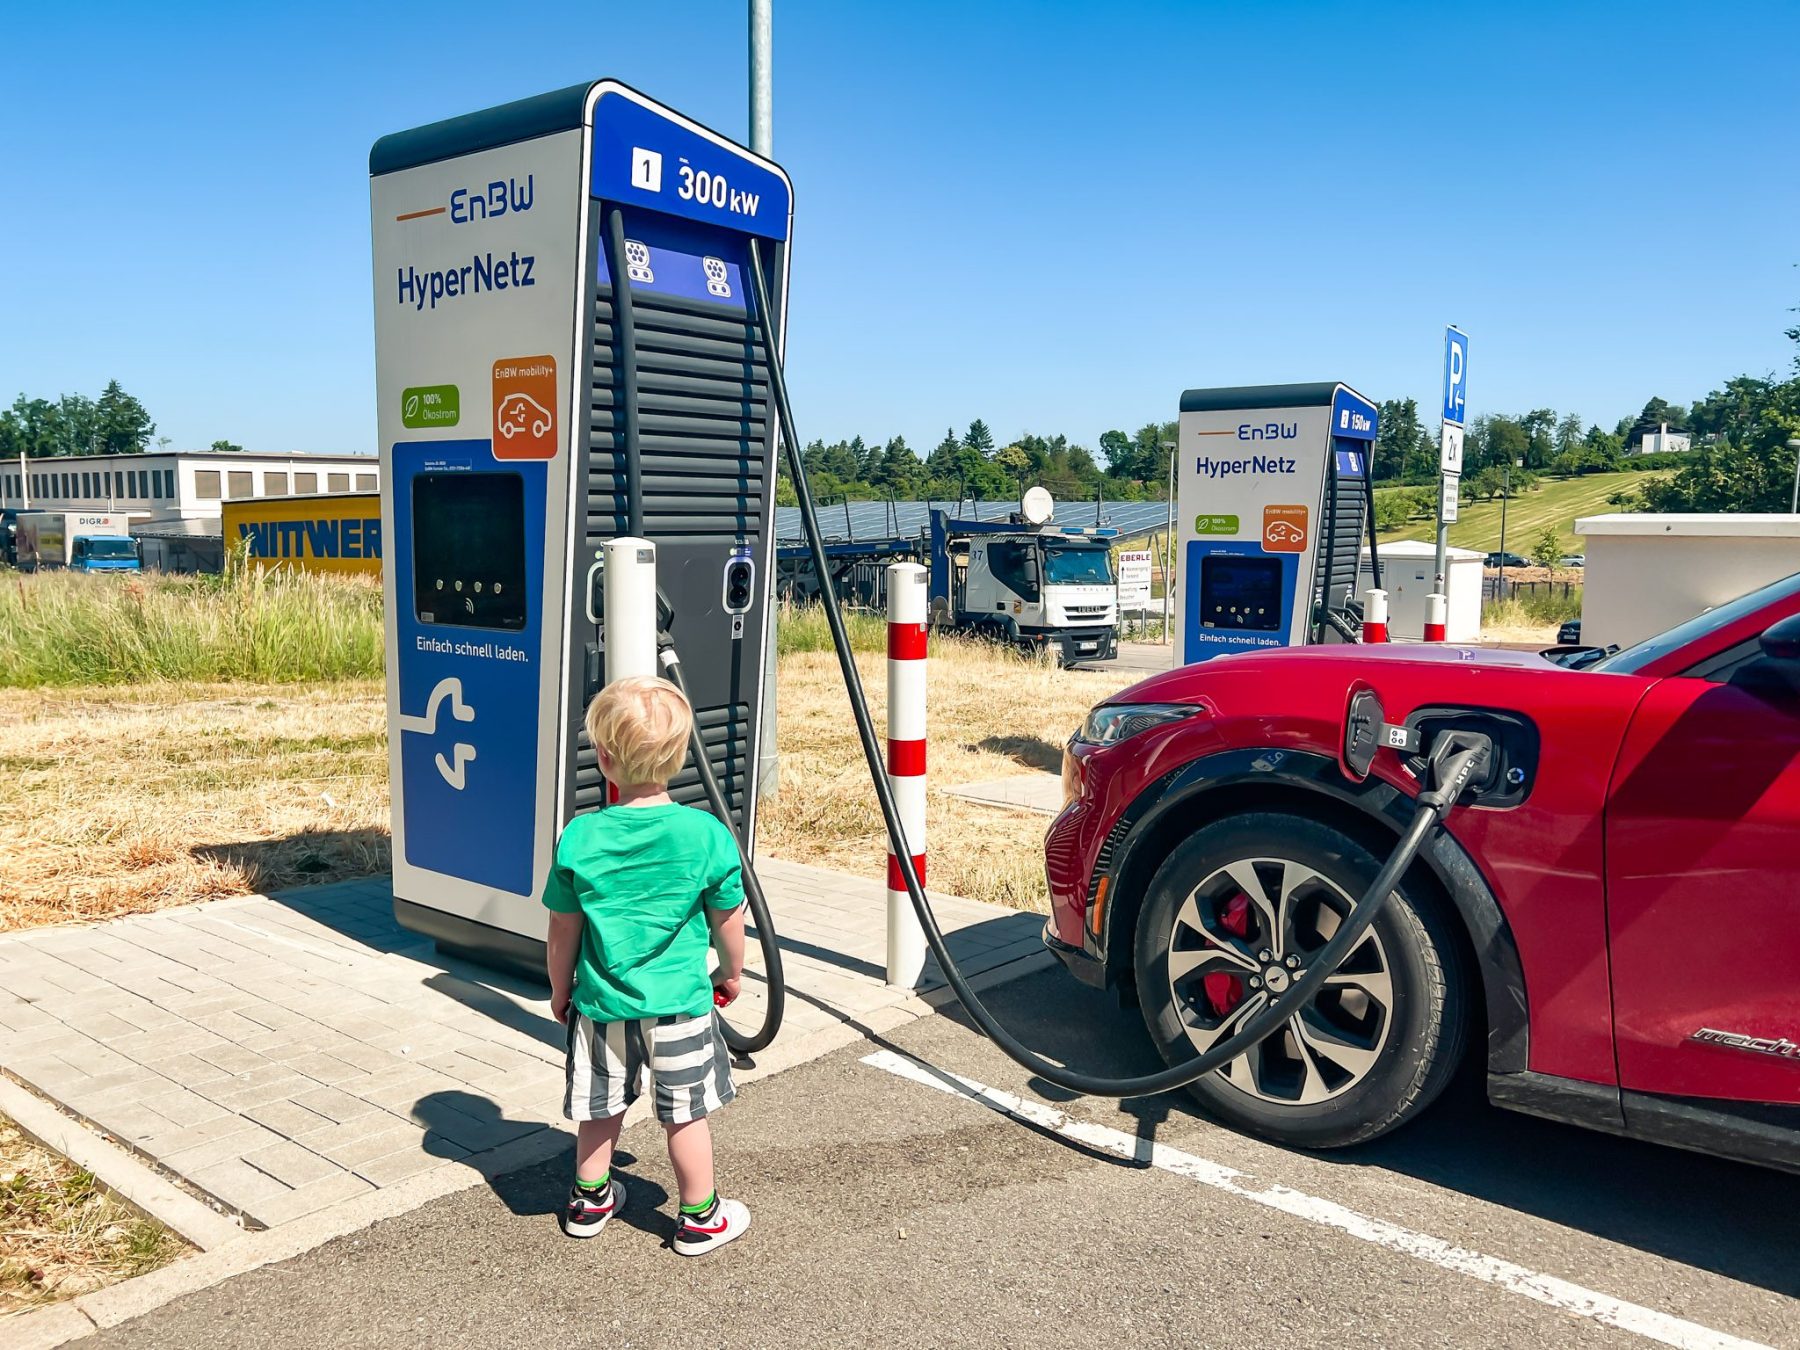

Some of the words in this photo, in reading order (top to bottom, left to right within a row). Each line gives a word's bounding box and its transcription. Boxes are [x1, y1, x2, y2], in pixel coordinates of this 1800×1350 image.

[450, 174, 535, 225] EnBW
[678, 166, 727, 209] 300
[730, 188, 760, 217] kW
[398, 251, 536, 310] HyperNetz
[495, 367, 517, 379] EnBW
[1448, 341, 1463, 409] P
[423, 393, 442, 405] 100%
[1237, 423, 1298, 441] EnBW
[1196, 456, 1296, 479] HyperNetz
[238, 518, 382, 559] WITTWER
[1120, 554, 1151, 562] EBERLE
[416, 636, 453, 654] Einfach
[455, 641, 493, 658] schnell
[495, 644, 529, 663] laden.
[1199, 633, 1227, 643] Einfach
[1228, 635, 1256, 645] schnell
[1257, 637, 1282, 646] laden.
[1455, 759, 1475, 785] HPC
